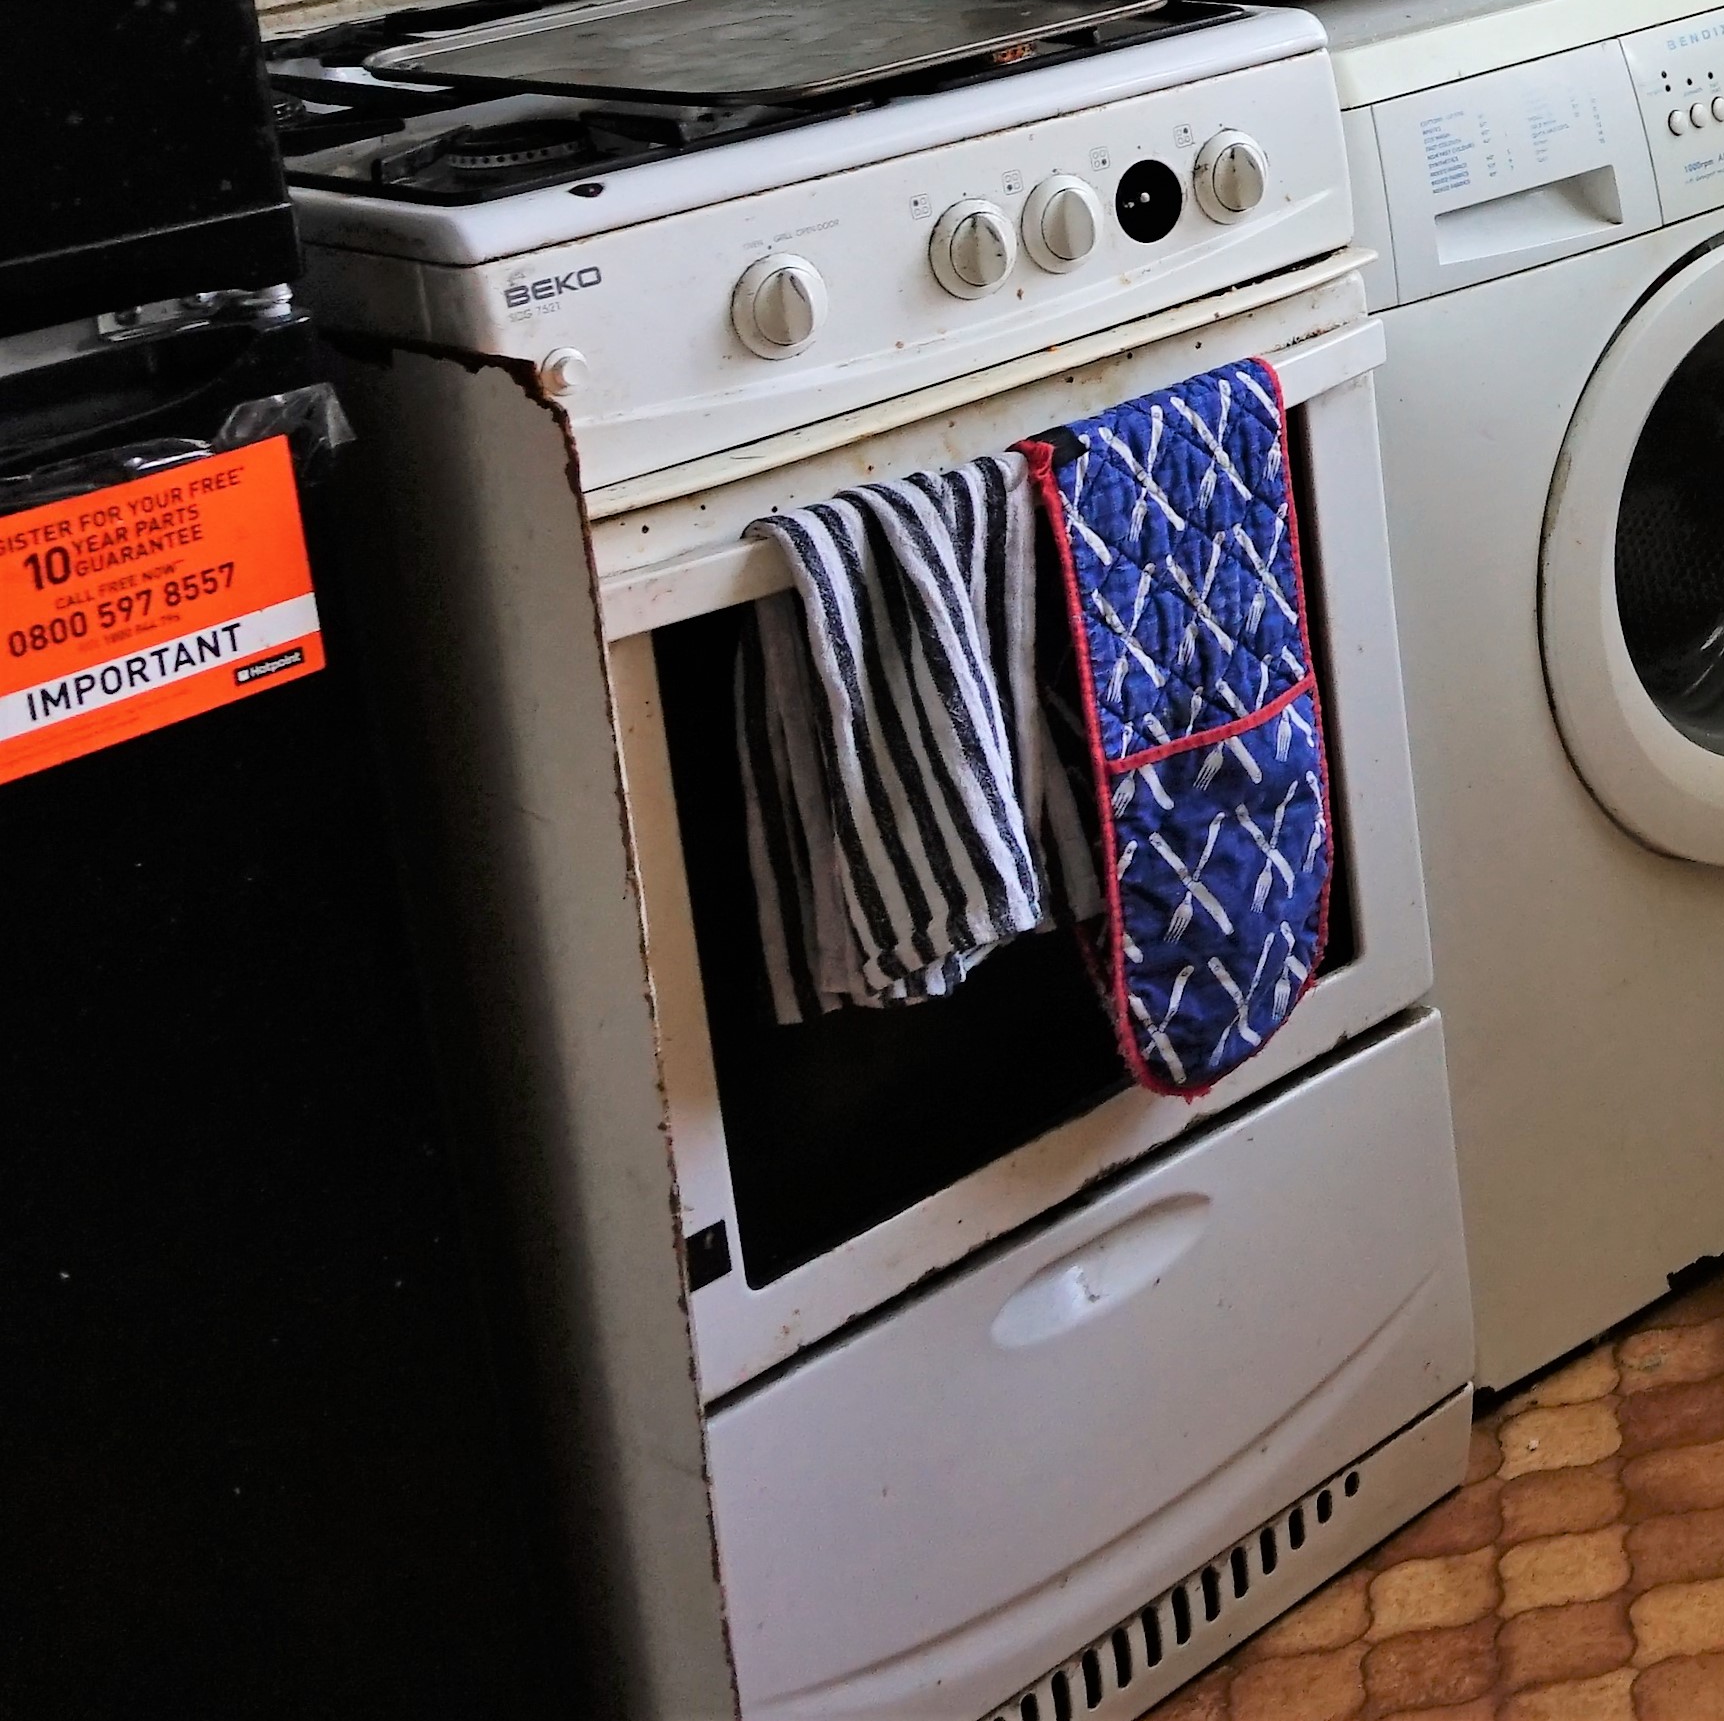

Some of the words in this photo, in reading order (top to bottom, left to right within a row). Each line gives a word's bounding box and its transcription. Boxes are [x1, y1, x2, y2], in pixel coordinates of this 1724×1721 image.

[503, 265, 602, 308] BEKO
[71, 526, 128, 555] YEAR
[135, 504, 200, 537] PARTS
[79, 505, 124, 533] FOR
[127, 487, 184, 516] YOUR
[23, 545, 71, 591] 10
[74, 523, 203, 577] GUARANTEE
[8, 611, 87, 658] 0800
[97, 589, 153, 628] 597
[163, 561, 235, 607] 8557
[55, 589, 95, 610] CALL
[97, 574, 138, 594] FREE
[26, 622, 241, 721] IMPORTANT
[250, 650, 302, 678] Hotpoint
